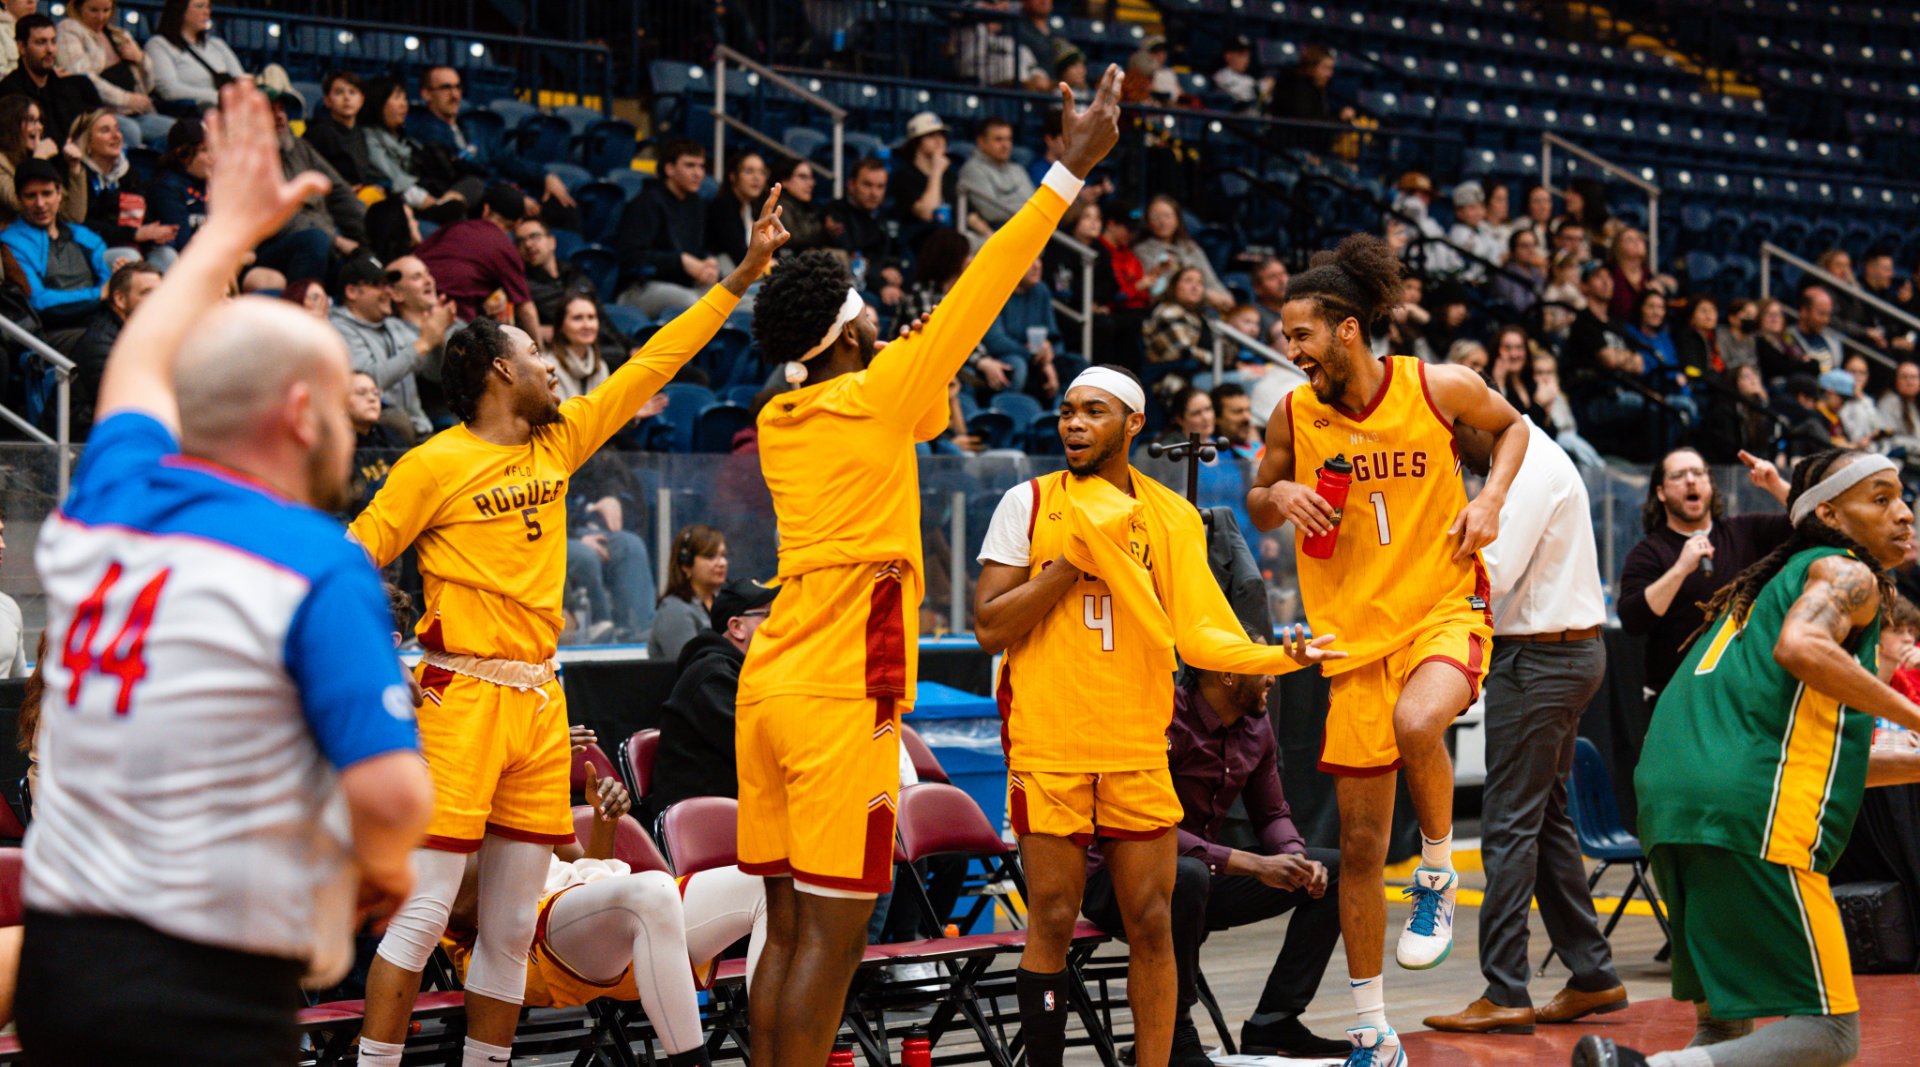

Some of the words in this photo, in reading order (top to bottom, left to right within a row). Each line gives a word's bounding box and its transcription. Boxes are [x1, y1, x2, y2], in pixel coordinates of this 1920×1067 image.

[503, 464, 532, 478] NFLD
[1315, 451, 1427, 483] GUES
[521, 506, 543, 543] 5
[1369, 490, 1391, 546] 1
[62, 560, 171, 717] 44
[1083, 594, 1114, 652] 4
